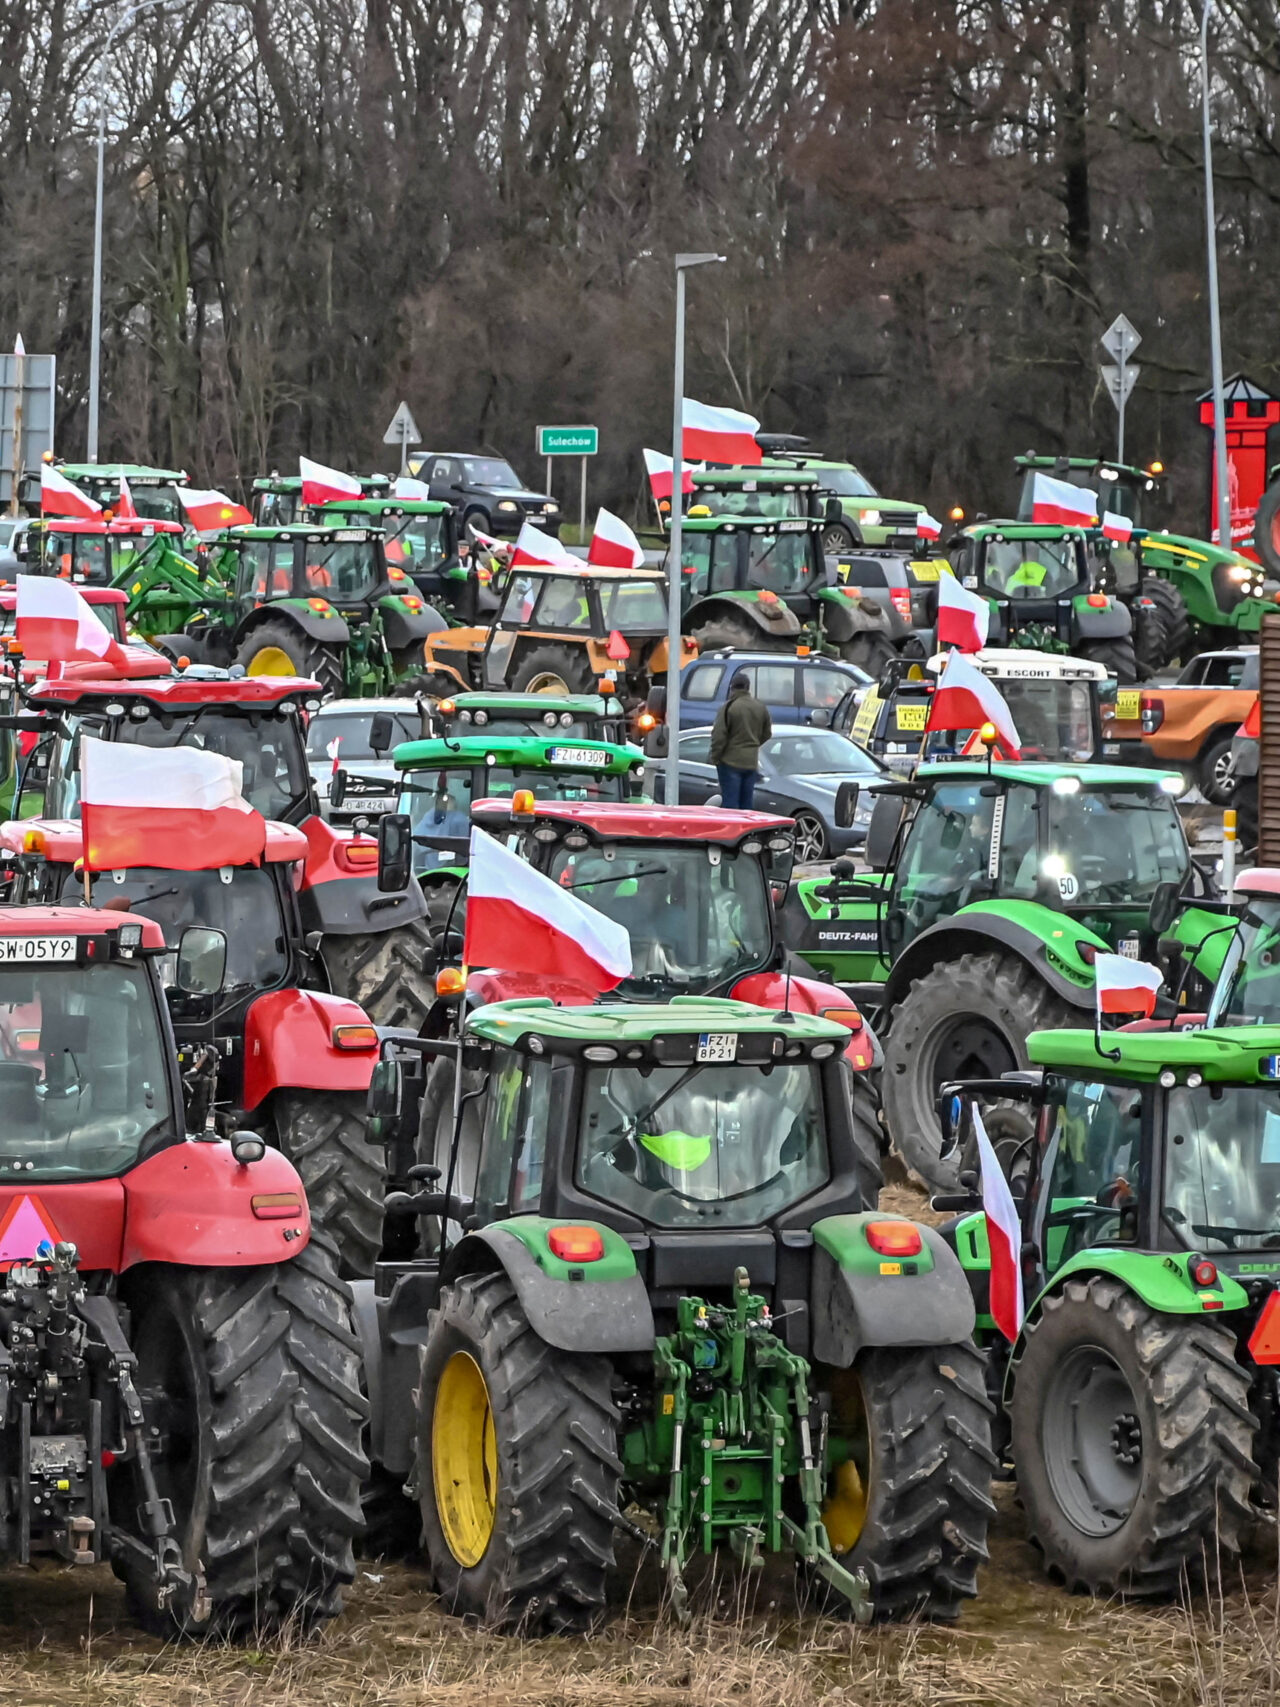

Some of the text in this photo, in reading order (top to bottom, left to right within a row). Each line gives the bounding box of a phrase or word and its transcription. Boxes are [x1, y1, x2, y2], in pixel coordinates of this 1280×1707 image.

[1007, 669, 1051, 677] ESCORT
[576, 751, 604, 763] 61309
[1060, 878, 1074, 895] 50
[24, 939, 72, 958] 05Y9
[708, 1035, 729, 1046] FZI
[700, 1048, 732, 1059] 8P21
